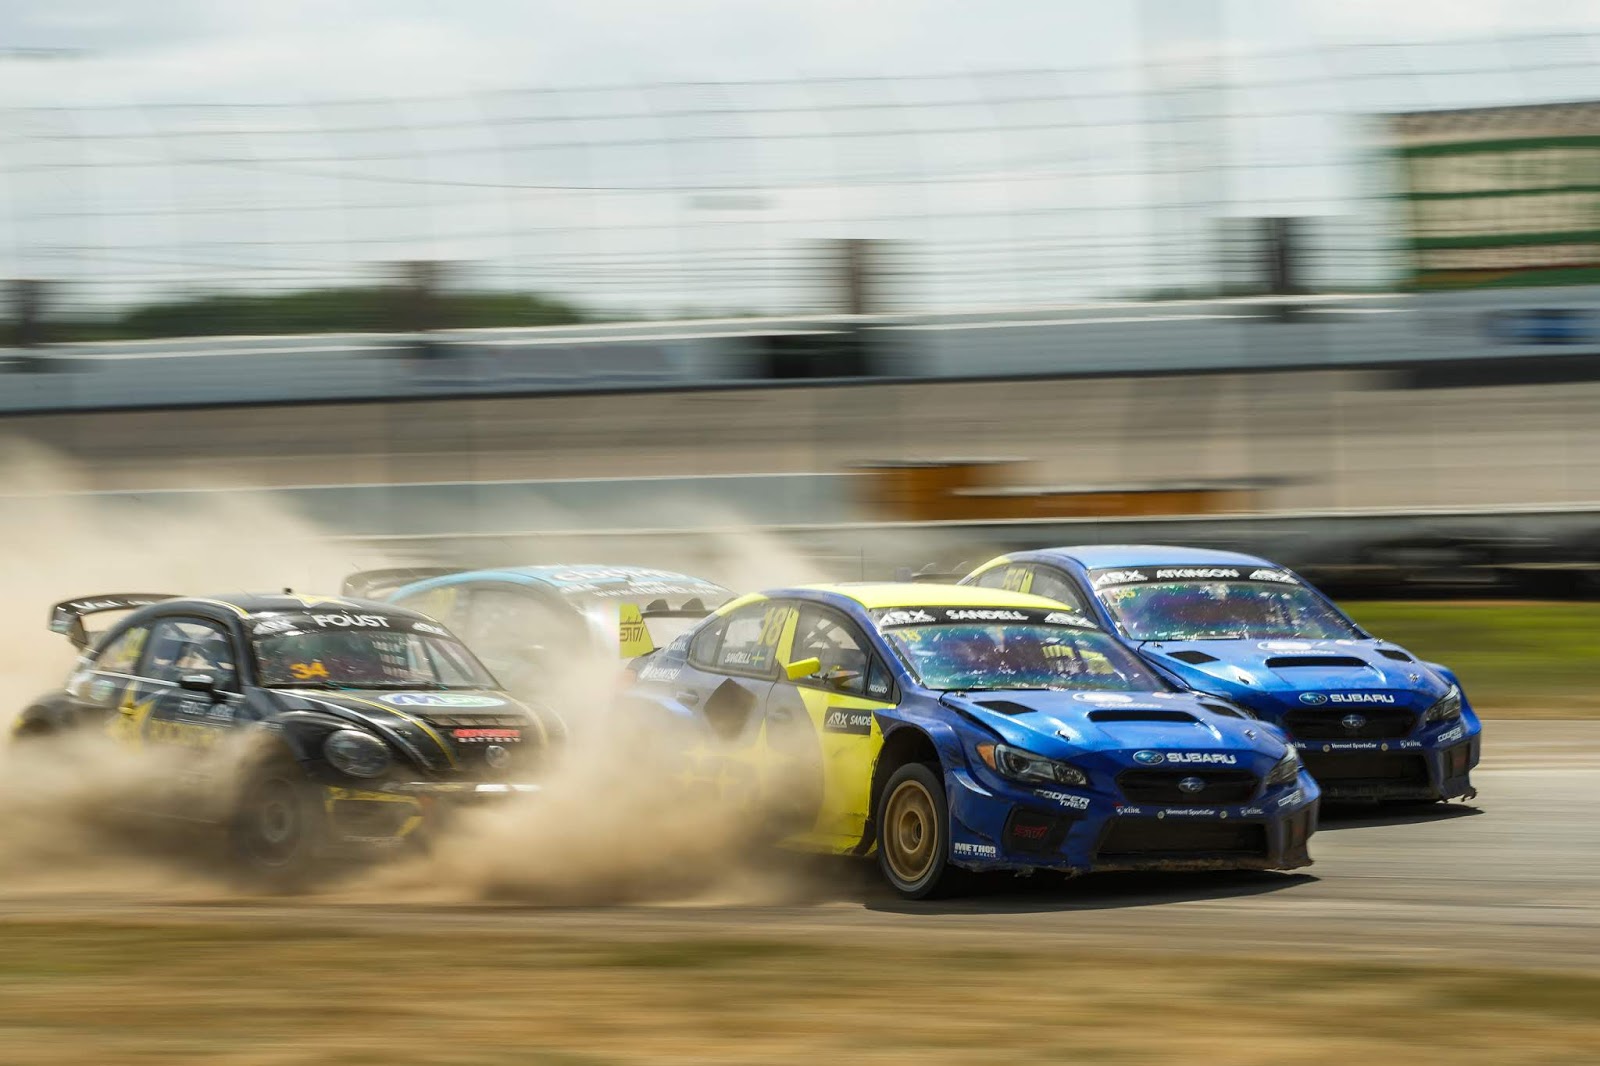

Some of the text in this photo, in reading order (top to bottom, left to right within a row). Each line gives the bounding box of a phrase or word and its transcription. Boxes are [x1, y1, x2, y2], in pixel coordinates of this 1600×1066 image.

[1156, 569, 1239, 579] ATKINSON
[311, 614, 389, 628] FOUST
[945, 609, 1029, 621] SANDELL
[290, 662, 329, 679] 34
[1329, 693, 1395, 704] SUBARU
[1166, 753, 1236, 764] SUBARU
[1034, 788, 1090, 805] COOPER
[954, 842, 996, 854] METHOD
